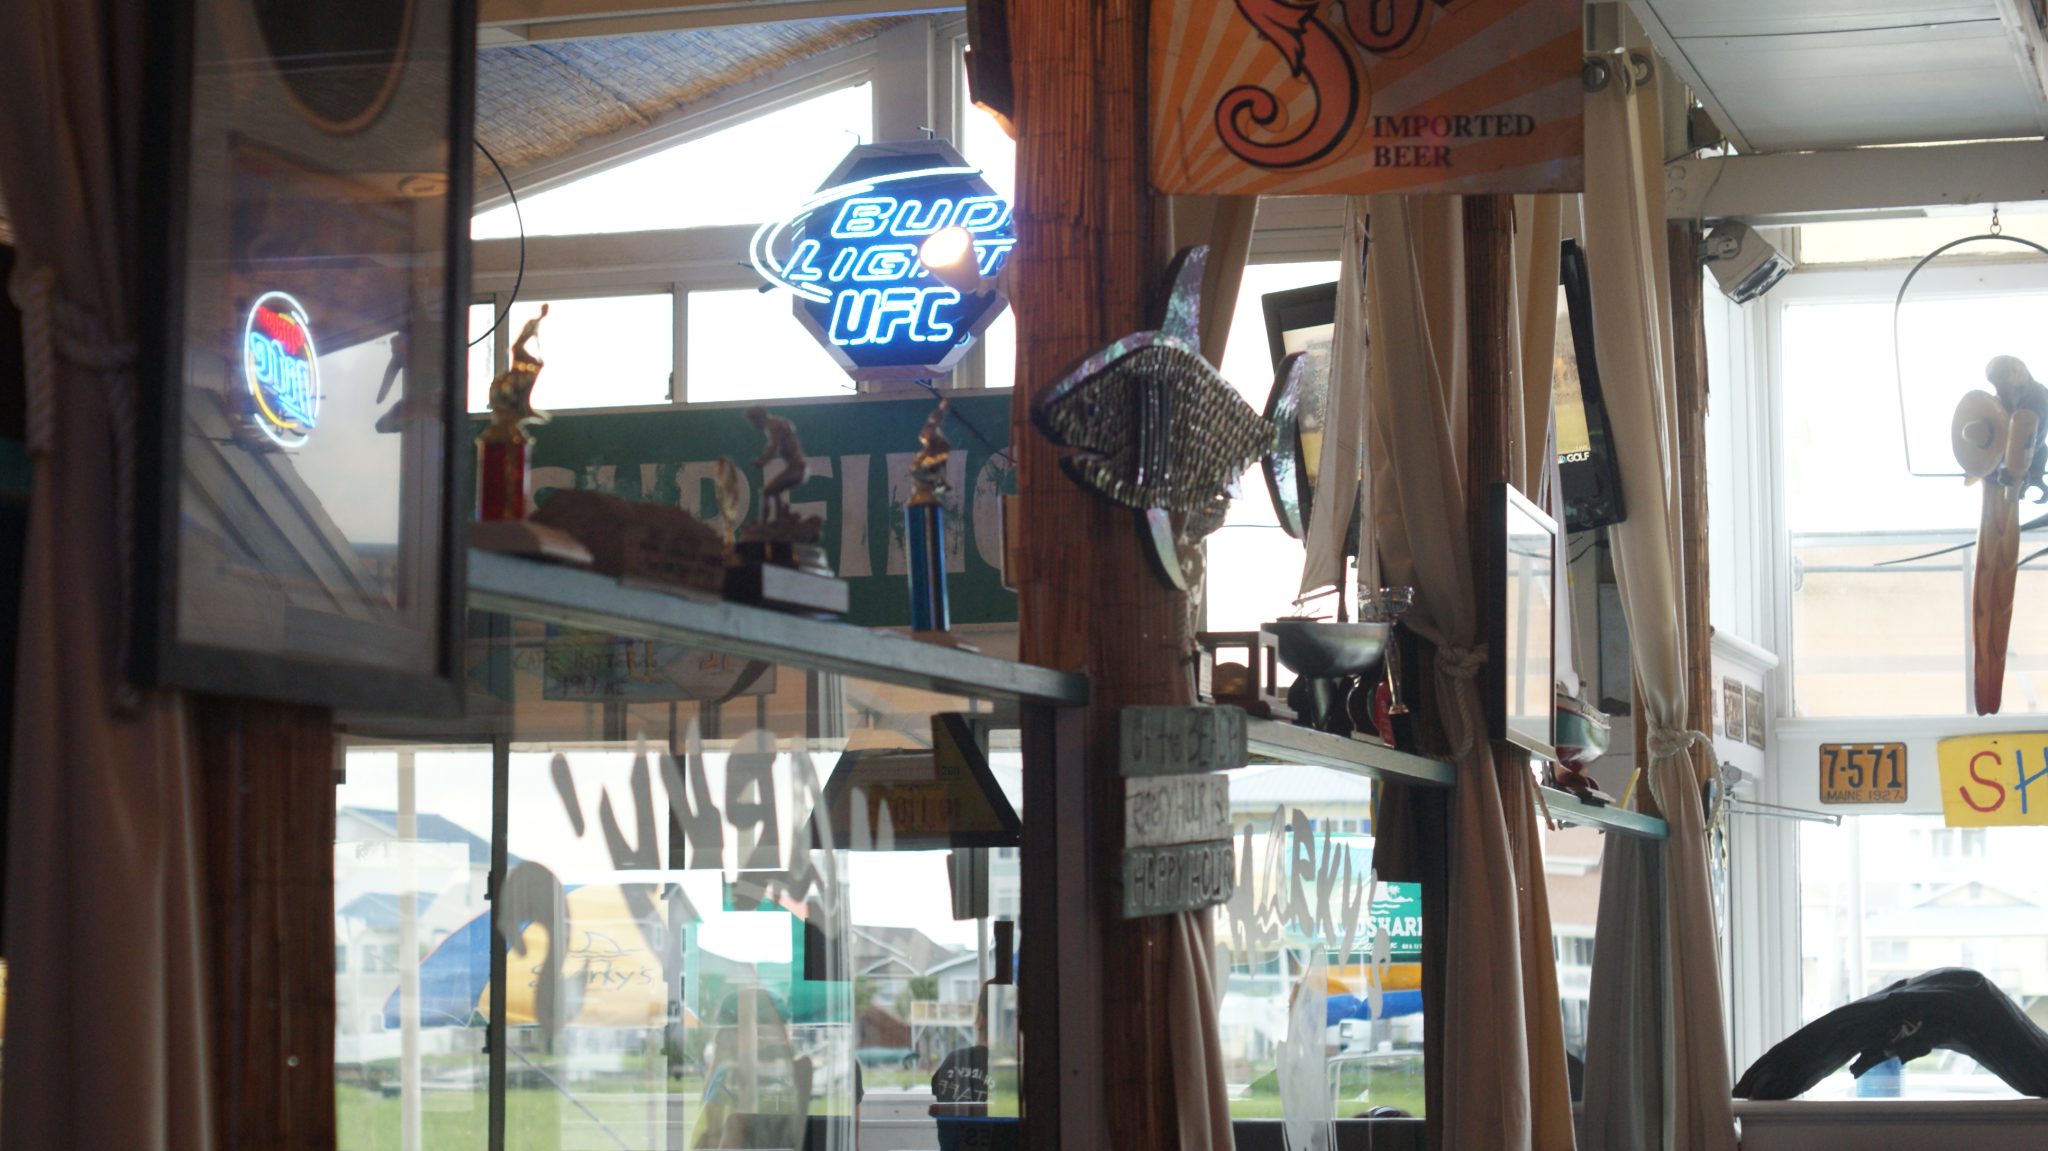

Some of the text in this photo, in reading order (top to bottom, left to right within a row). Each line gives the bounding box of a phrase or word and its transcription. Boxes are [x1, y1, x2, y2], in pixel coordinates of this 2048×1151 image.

[1373, 113, 1535, 138] IMPORTED
[1373, 144, 1453, 168] BEER
[830, 196, 1014, 239] BUD
[781, 238, 1016, 282] LIGT
[828, 286, 960, 345] UFC
[1566, 452, 1590, 463] GOLF
[1824, 749, 1902, 788] 7-571
[1827, 789, 1900, 801] MAINE 1927
[1132, 847, 1234, 907] HAPPY HOUR
